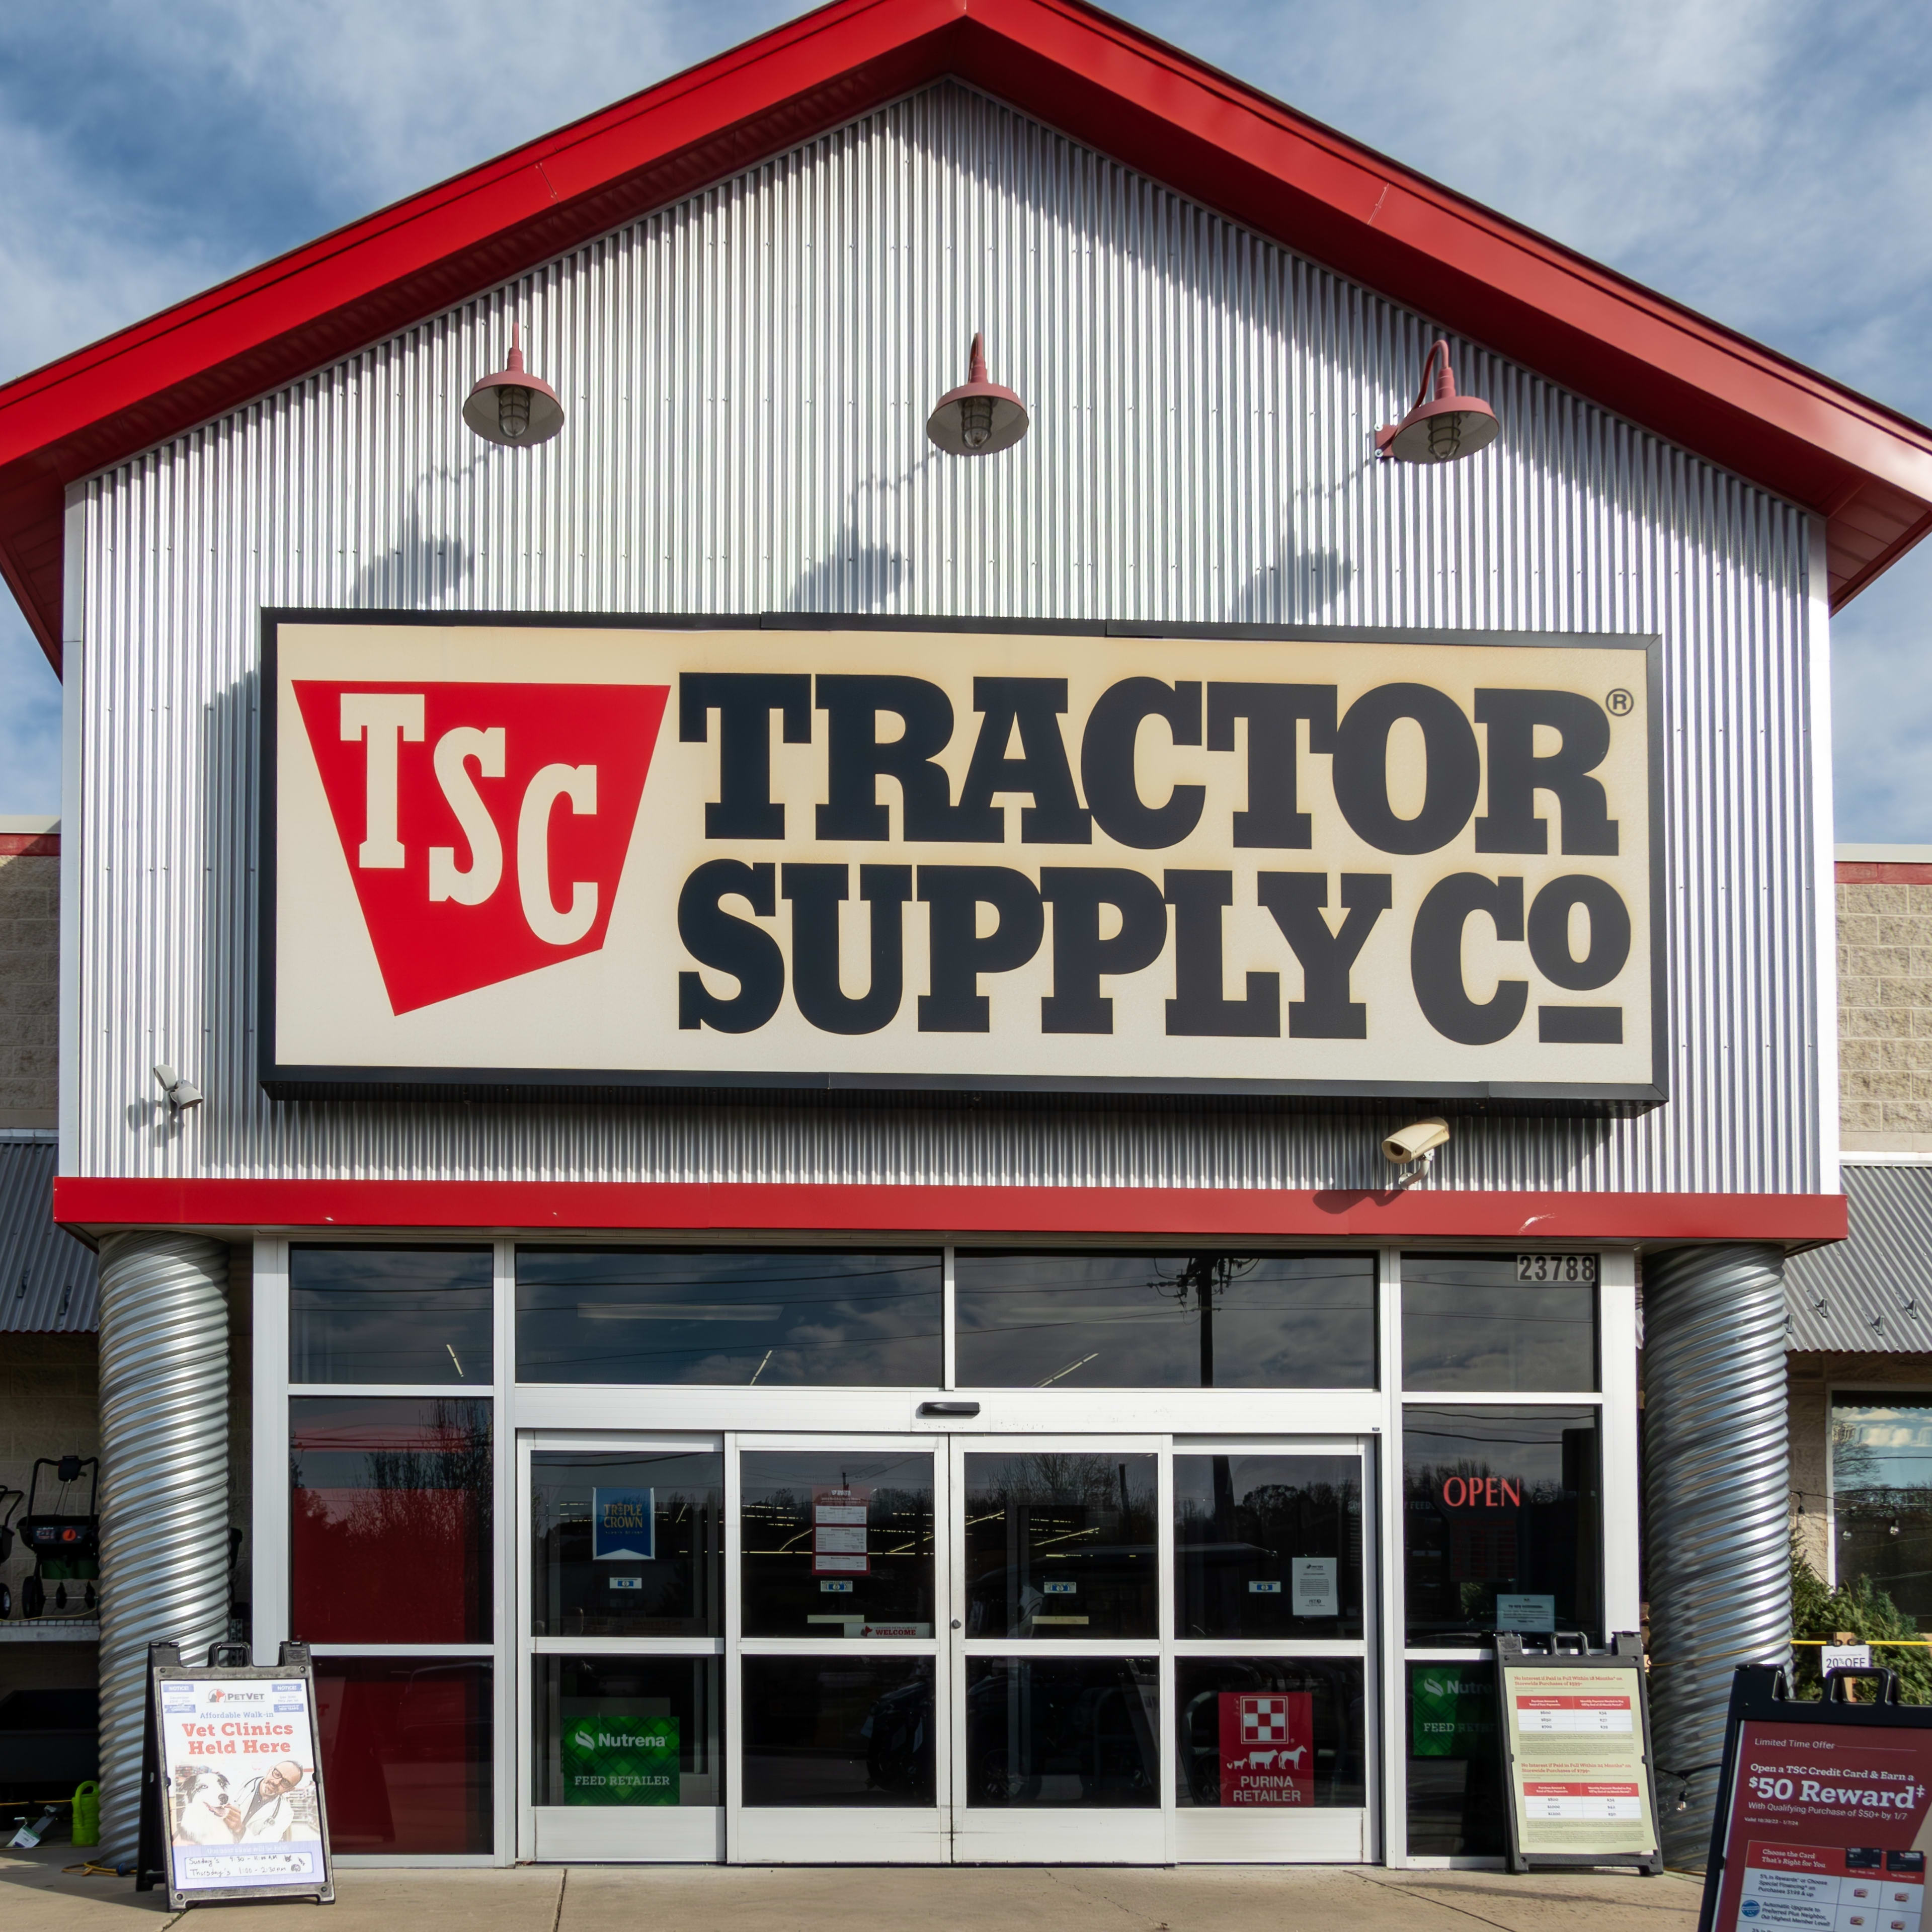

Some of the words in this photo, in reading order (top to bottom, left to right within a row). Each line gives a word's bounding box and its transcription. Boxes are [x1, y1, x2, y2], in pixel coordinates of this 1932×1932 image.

[679, 672, 1619, 856] TRACTOR
[341, 693, 598, 945] TSC
[678, 859, 1392, 1039] SUPPLY
[1519, 1255, 1594, 1281] 23788
[1443, 1477, 1520, 1507] OPEN
[604, 1516, 643, 1528] CROWN
[1845, 1658, 1866, 1667] OFF
[182, 1723, 215, 1737] Vet
[221, 1722, 293, 1736] Clinics
[1423, 1723, 1455, 1732] FEED
[188, 1740, 236, 1754] Held
[243, 1740, 291, 1753] Here
[599, 1733, 665, 1747] Nutrena
[1755, 1738, 1787, 1747] Limited
[1789, 1740, 1810, 1748] Time
[1812, 1741, 1835, 1749] Offer
[1750, 1763, 1777, 1774] Open
[1786, 1765, 1807, 1775] TSC
[1808, 1767, 1841, 1777] Credit
[1843, 1769, 1868, 1779] Card
[1870, 1771, 1879, 1779] &
[1881, 1772, 1906, 1781] Earn
[575, 1776, 606, 1786] FEED
[609, 1776, 670, 1786] RETAILER
[1241, 1776, 1294, 1788] PURINA
[1748, 1776, 1793, 1800] $50
[1233, 1790, 1302, 1802] RETAILER
[1748, 1802, 1765, 1810] With
[1767, 1804, 1806, 1815] Qualifying
[1808, 1806, 1845, 1816] Purchase
[1858, 1809, 1879, 1818] $50+
[1881, 1811, 1891, 1820] by
[189, 1857, 219, 1867] Sunday's
[190, 1868, 230, 1878] Thursday's
